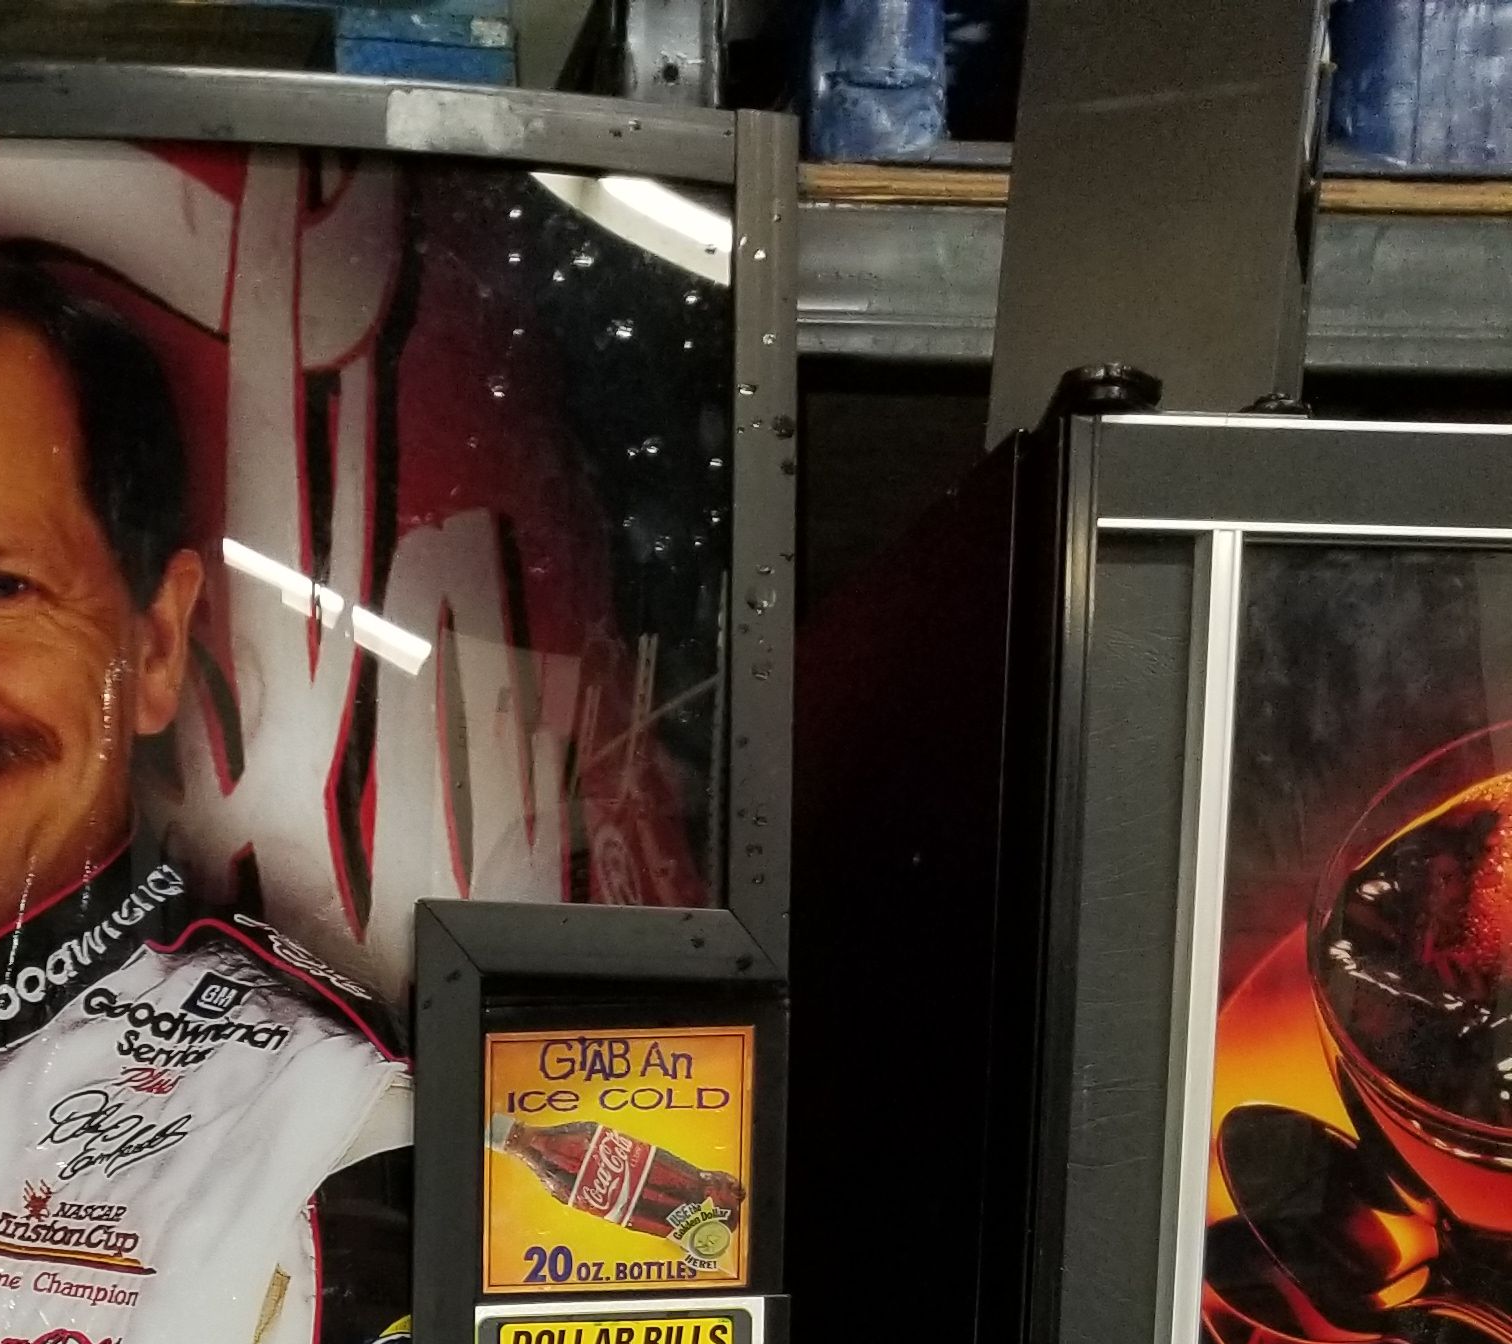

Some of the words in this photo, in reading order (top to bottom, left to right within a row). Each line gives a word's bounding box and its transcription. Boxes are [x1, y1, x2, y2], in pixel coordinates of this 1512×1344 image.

[201, 984, 238, 1006] GM
[117, 1029, 212, 1067] Service
[599, 1087, 730, 1111] COLD
[52, 1202, 127, 1222] NASCAR
[86, 1224, 139, 1257] Cup
[523, 1246, 573, 1283] 20
[33, 1271, 139, 1307] Champion
